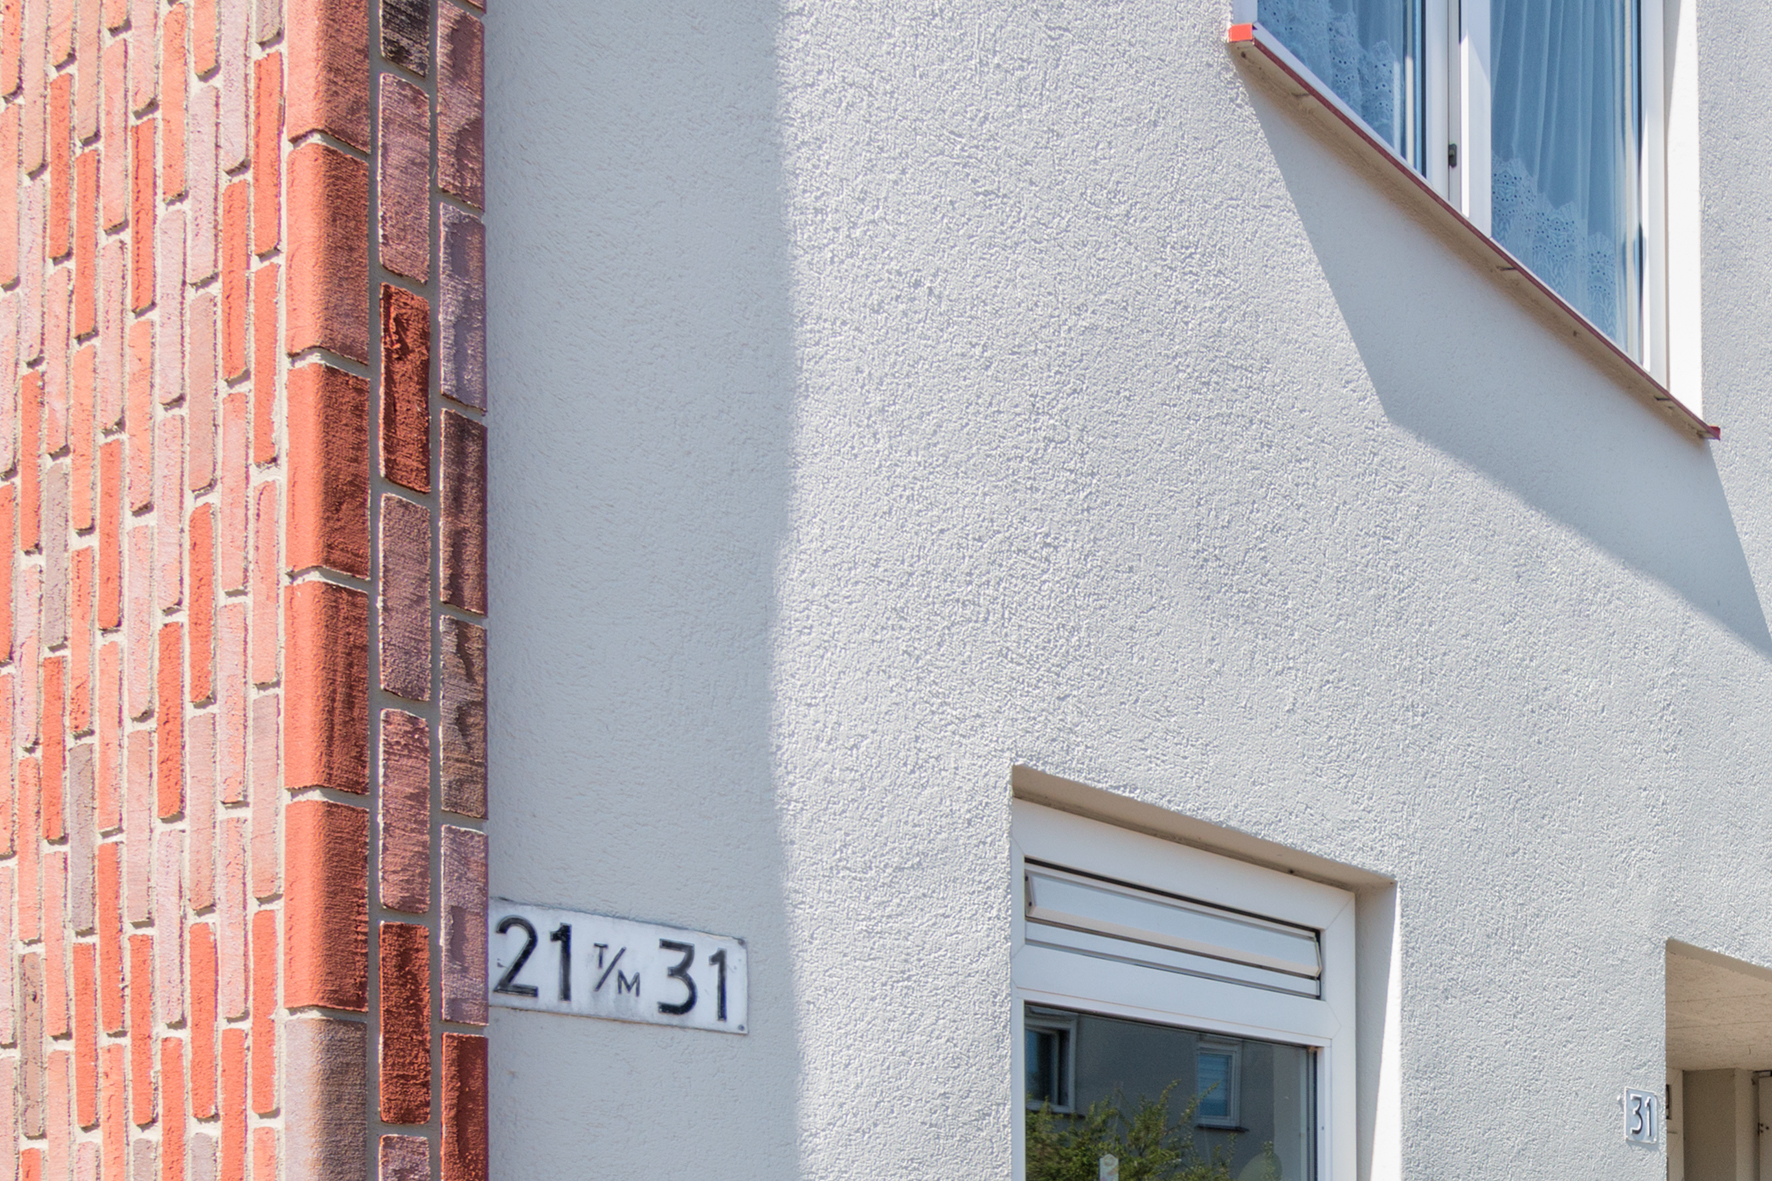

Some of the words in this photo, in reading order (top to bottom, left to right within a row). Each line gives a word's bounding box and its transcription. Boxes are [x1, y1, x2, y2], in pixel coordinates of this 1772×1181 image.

[493, 915, 572, 1002] 21
[657, 937, 728, 1022] 31
[1629, 1093, 1652, 1137] 31
